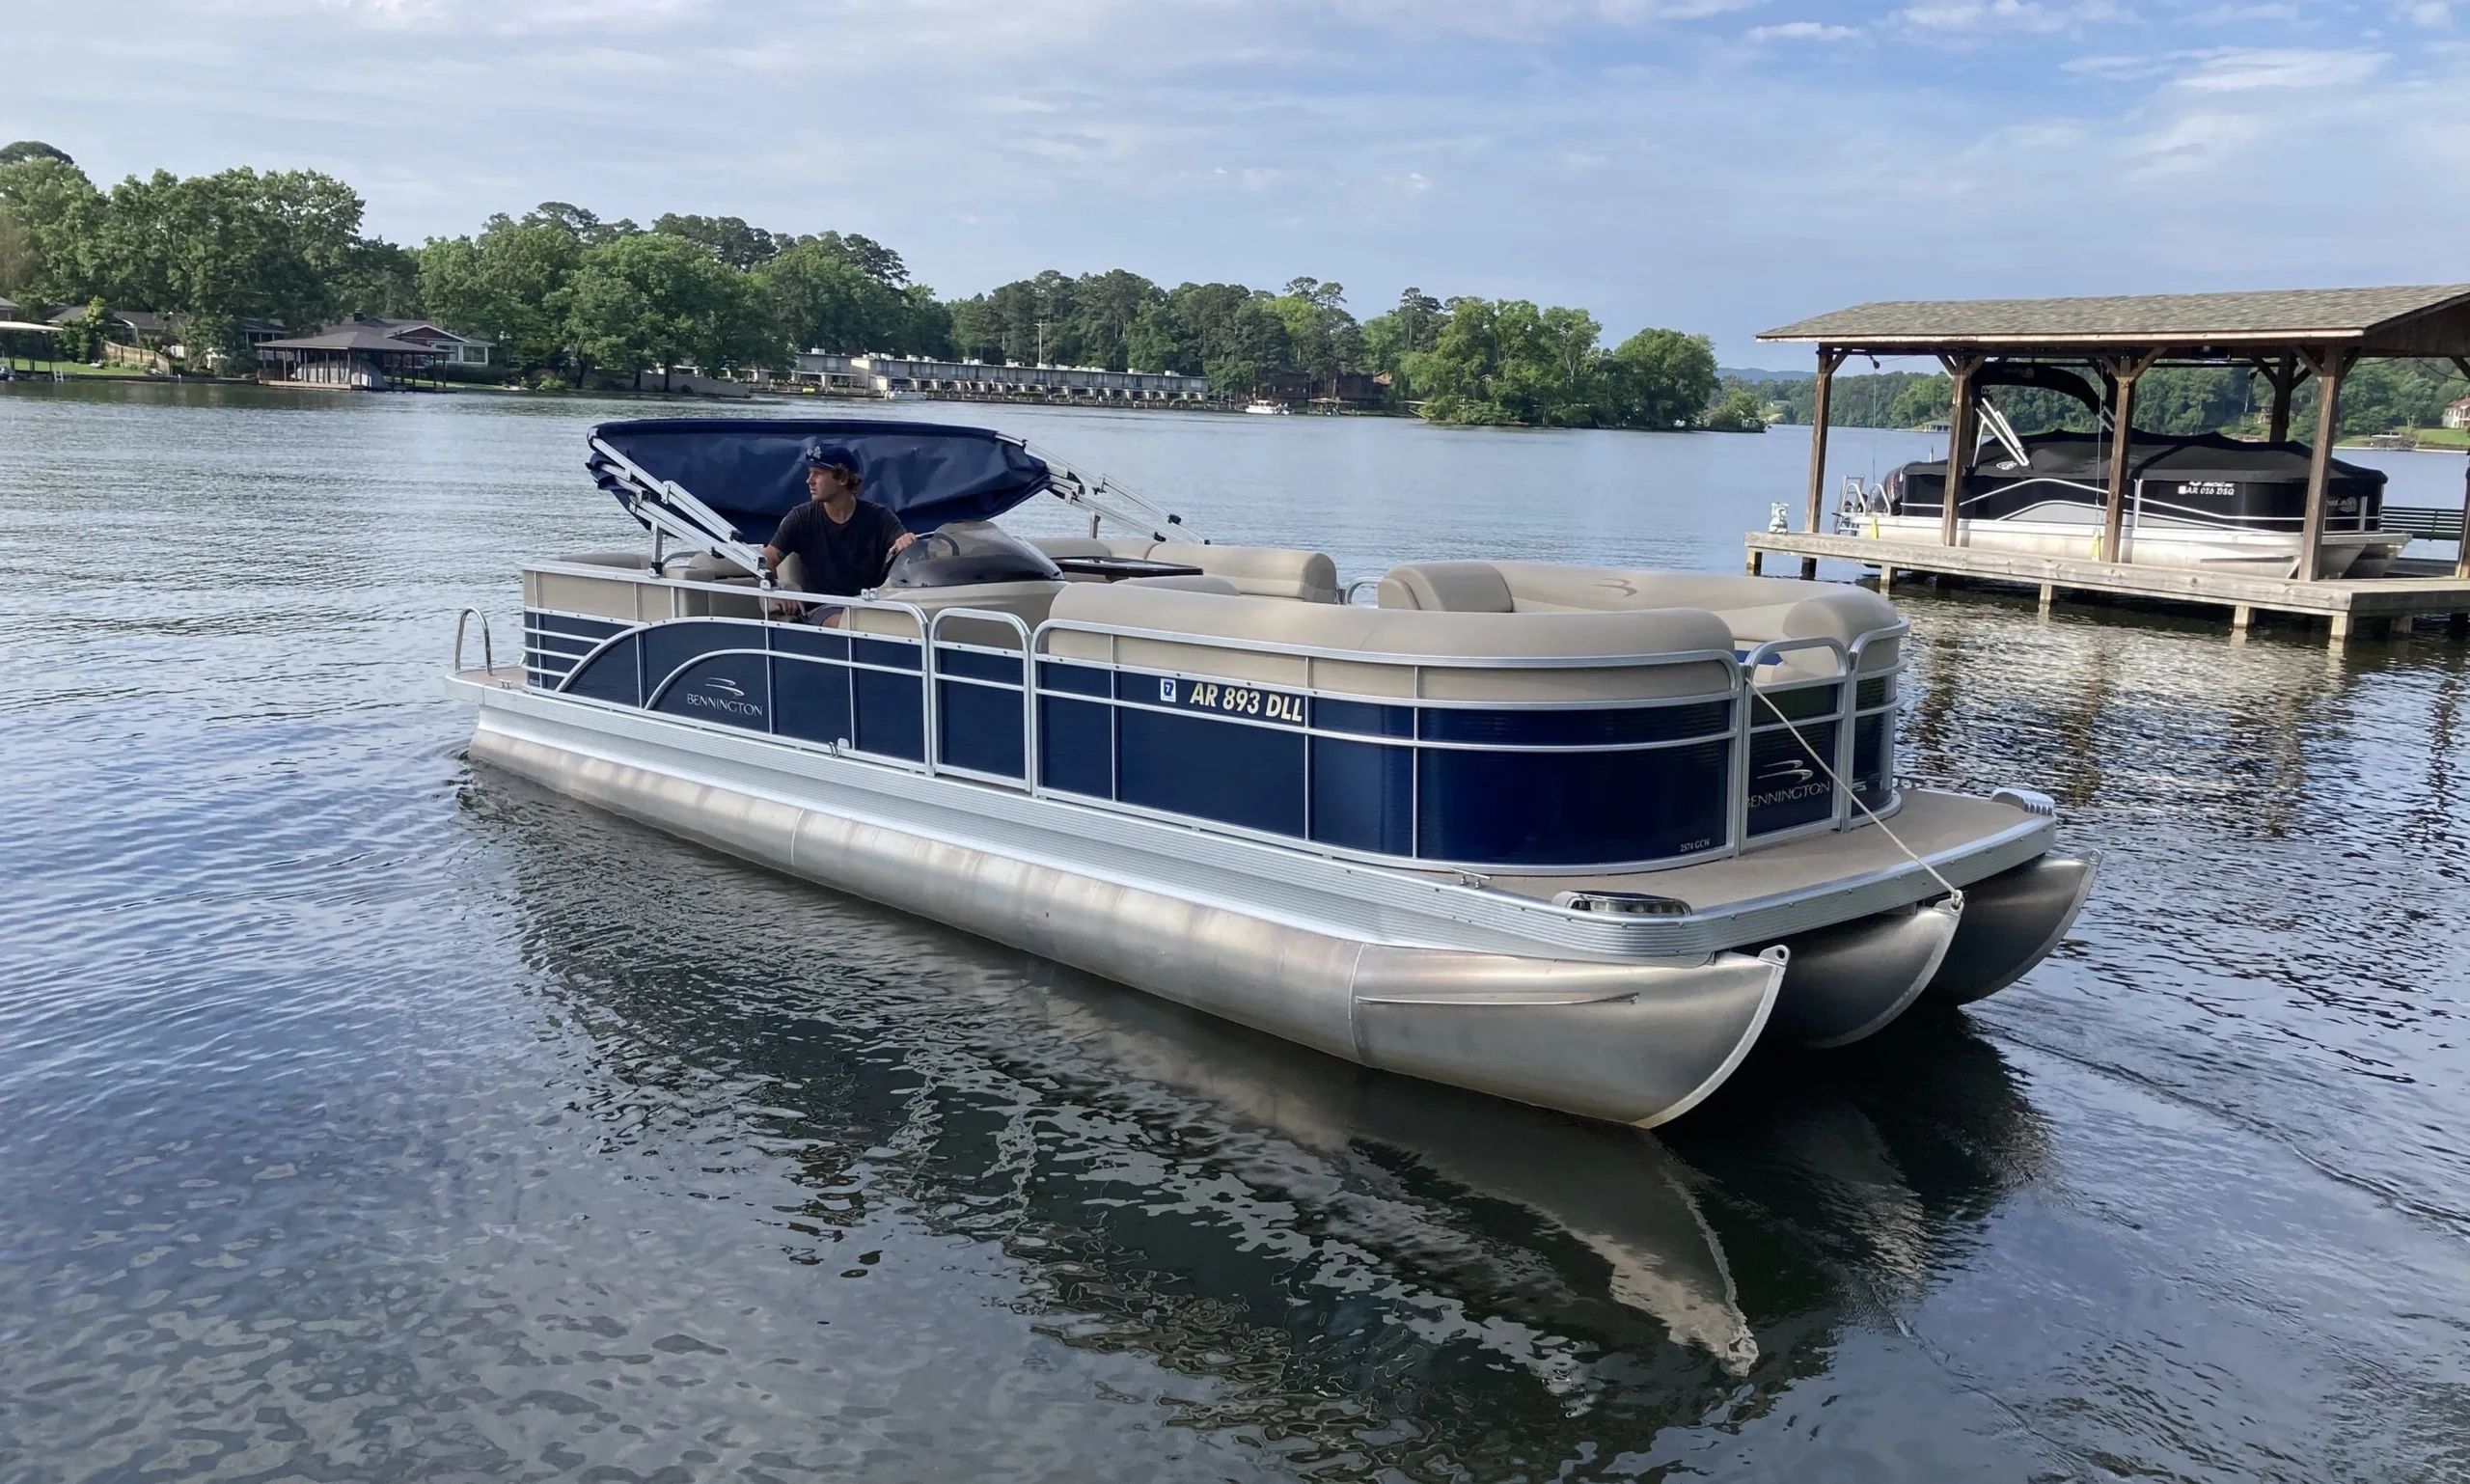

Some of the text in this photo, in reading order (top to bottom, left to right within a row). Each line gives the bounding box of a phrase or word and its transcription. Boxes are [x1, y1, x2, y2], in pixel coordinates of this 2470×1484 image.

[2185, 485, 2199, 495] AR
[686, 693, 763, 717] BENNINGTON
[1189, 681, 1303, 723] AR 893 DLL
